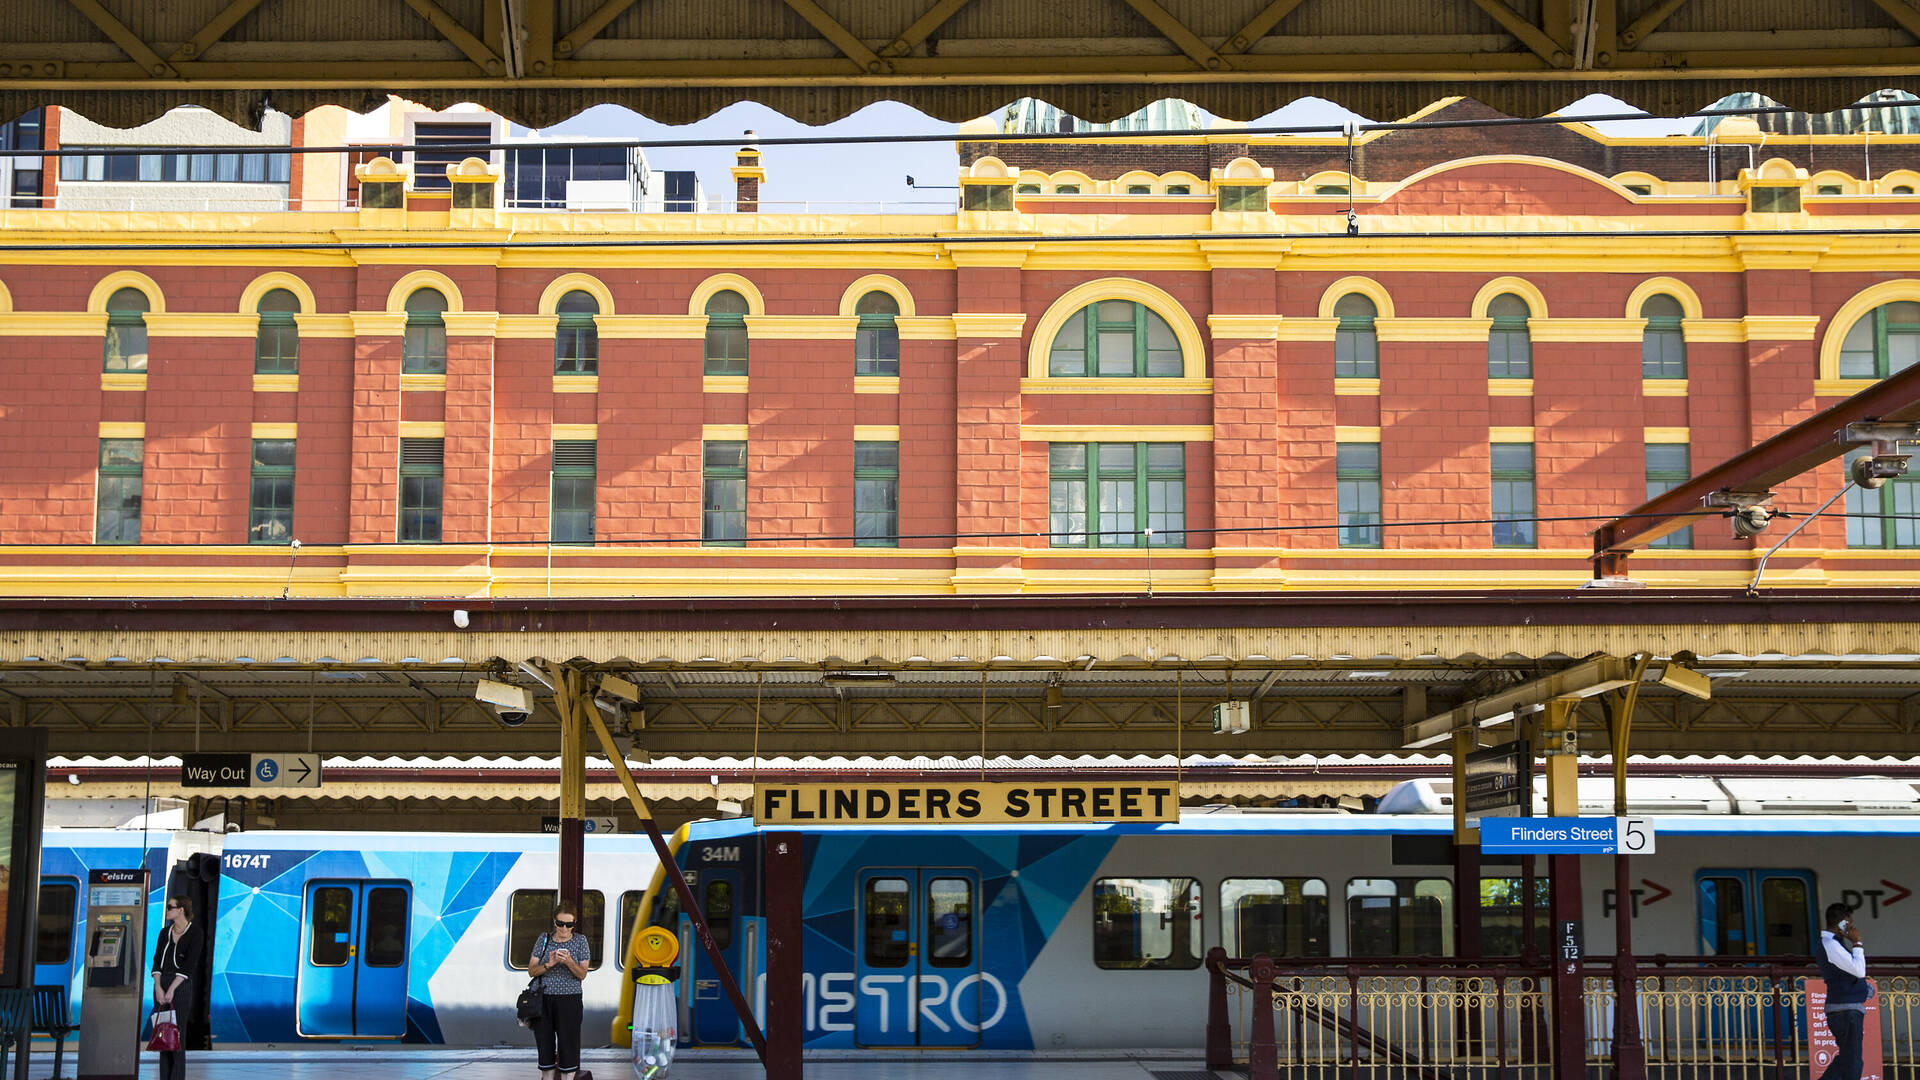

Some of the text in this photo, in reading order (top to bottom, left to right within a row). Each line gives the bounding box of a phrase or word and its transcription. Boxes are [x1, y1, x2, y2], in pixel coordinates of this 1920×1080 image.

[187, 767, 246, 782] Way Out
[764, 787, 1171, 820] FLINDERS STREET
[1511, 827, 1613, 841] Flinders Street
[1625, 820, 1646, 850] 5
[702, 846, 740, 862] 34M
[224, 854, 271, 869] 1674T
[100, 872, 134, 882] Telstra
[1566, 922, 1574, 933] F
[1566, 935, 1574, 946] 5
[1564, 948, 1578, 959] 12
[1812, 1012, 1827, 1020] Lig
